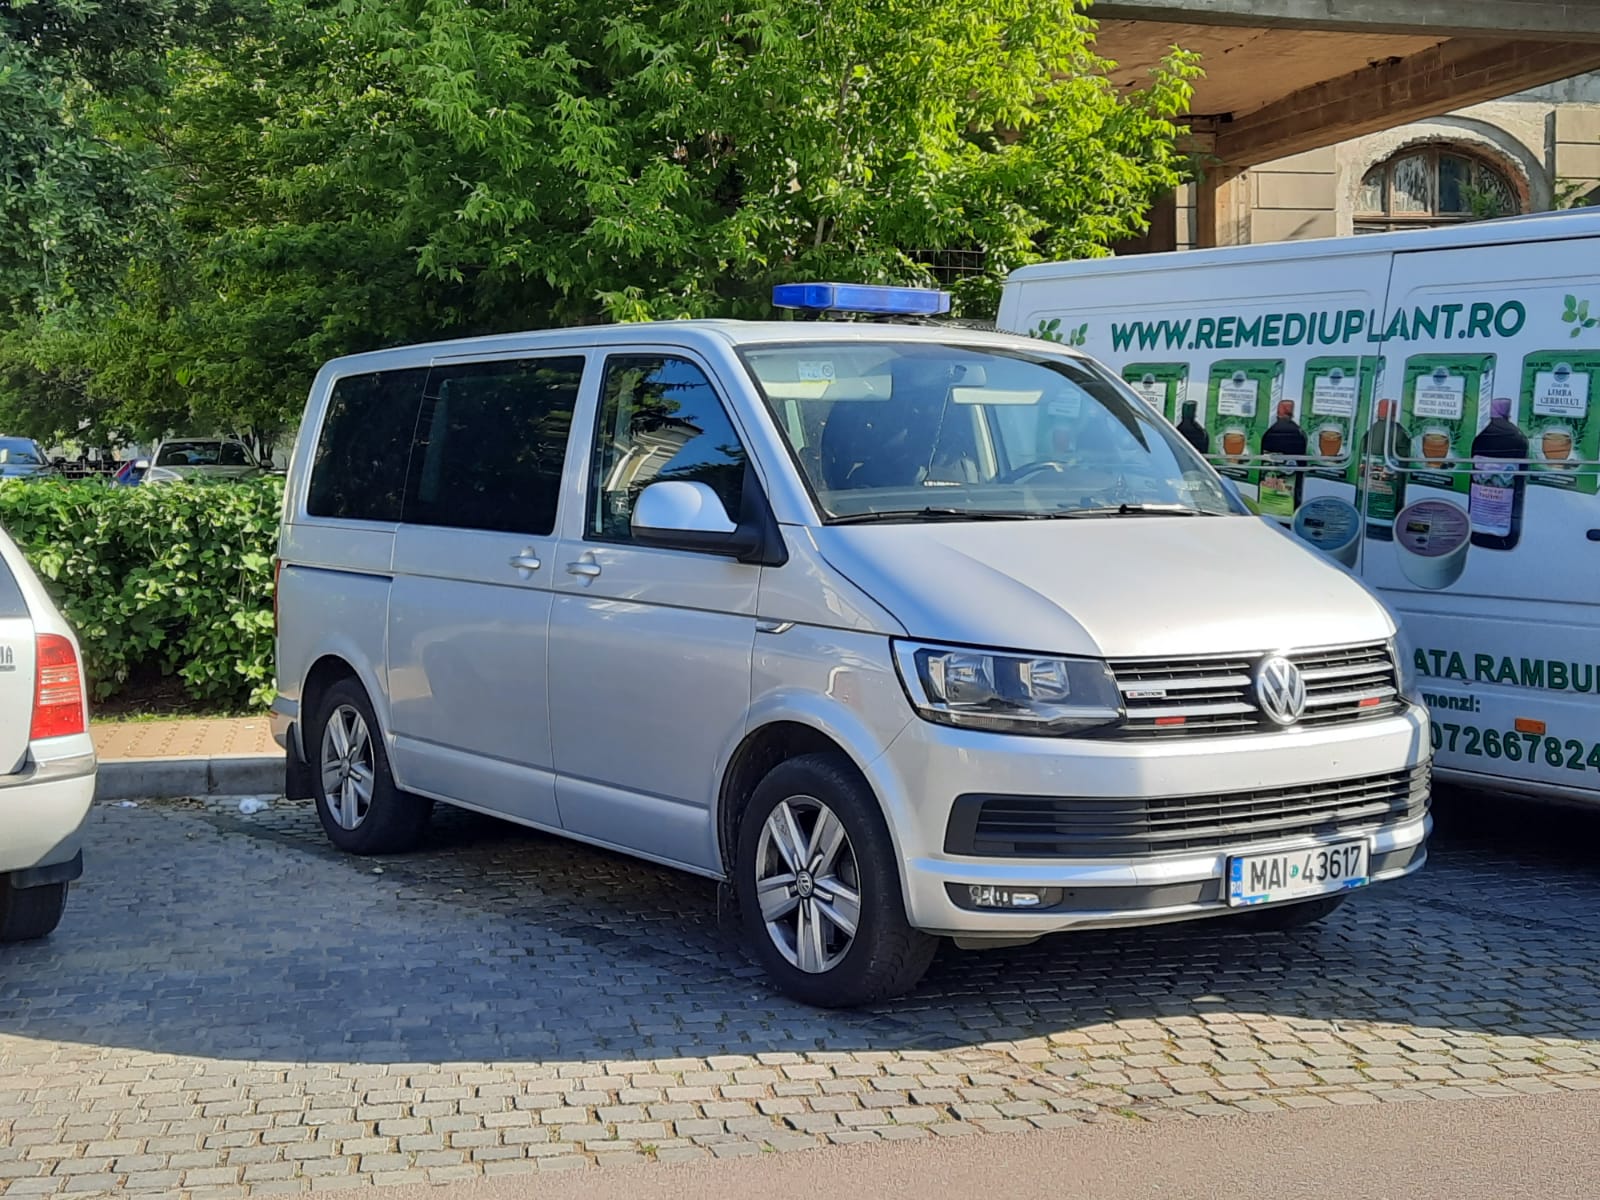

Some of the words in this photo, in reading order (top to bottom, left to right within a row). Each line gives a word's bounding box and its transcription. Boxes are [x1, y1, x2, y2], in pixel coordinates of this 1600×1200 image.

[1111, 300, 1526, 353] WWW.REMEDIUPLANT.RO
[1474, 653, 1600, 694] RAMBU
[1250, 857, 1288, 892] MAI
[1301, 844, 1362, 884] 43617
